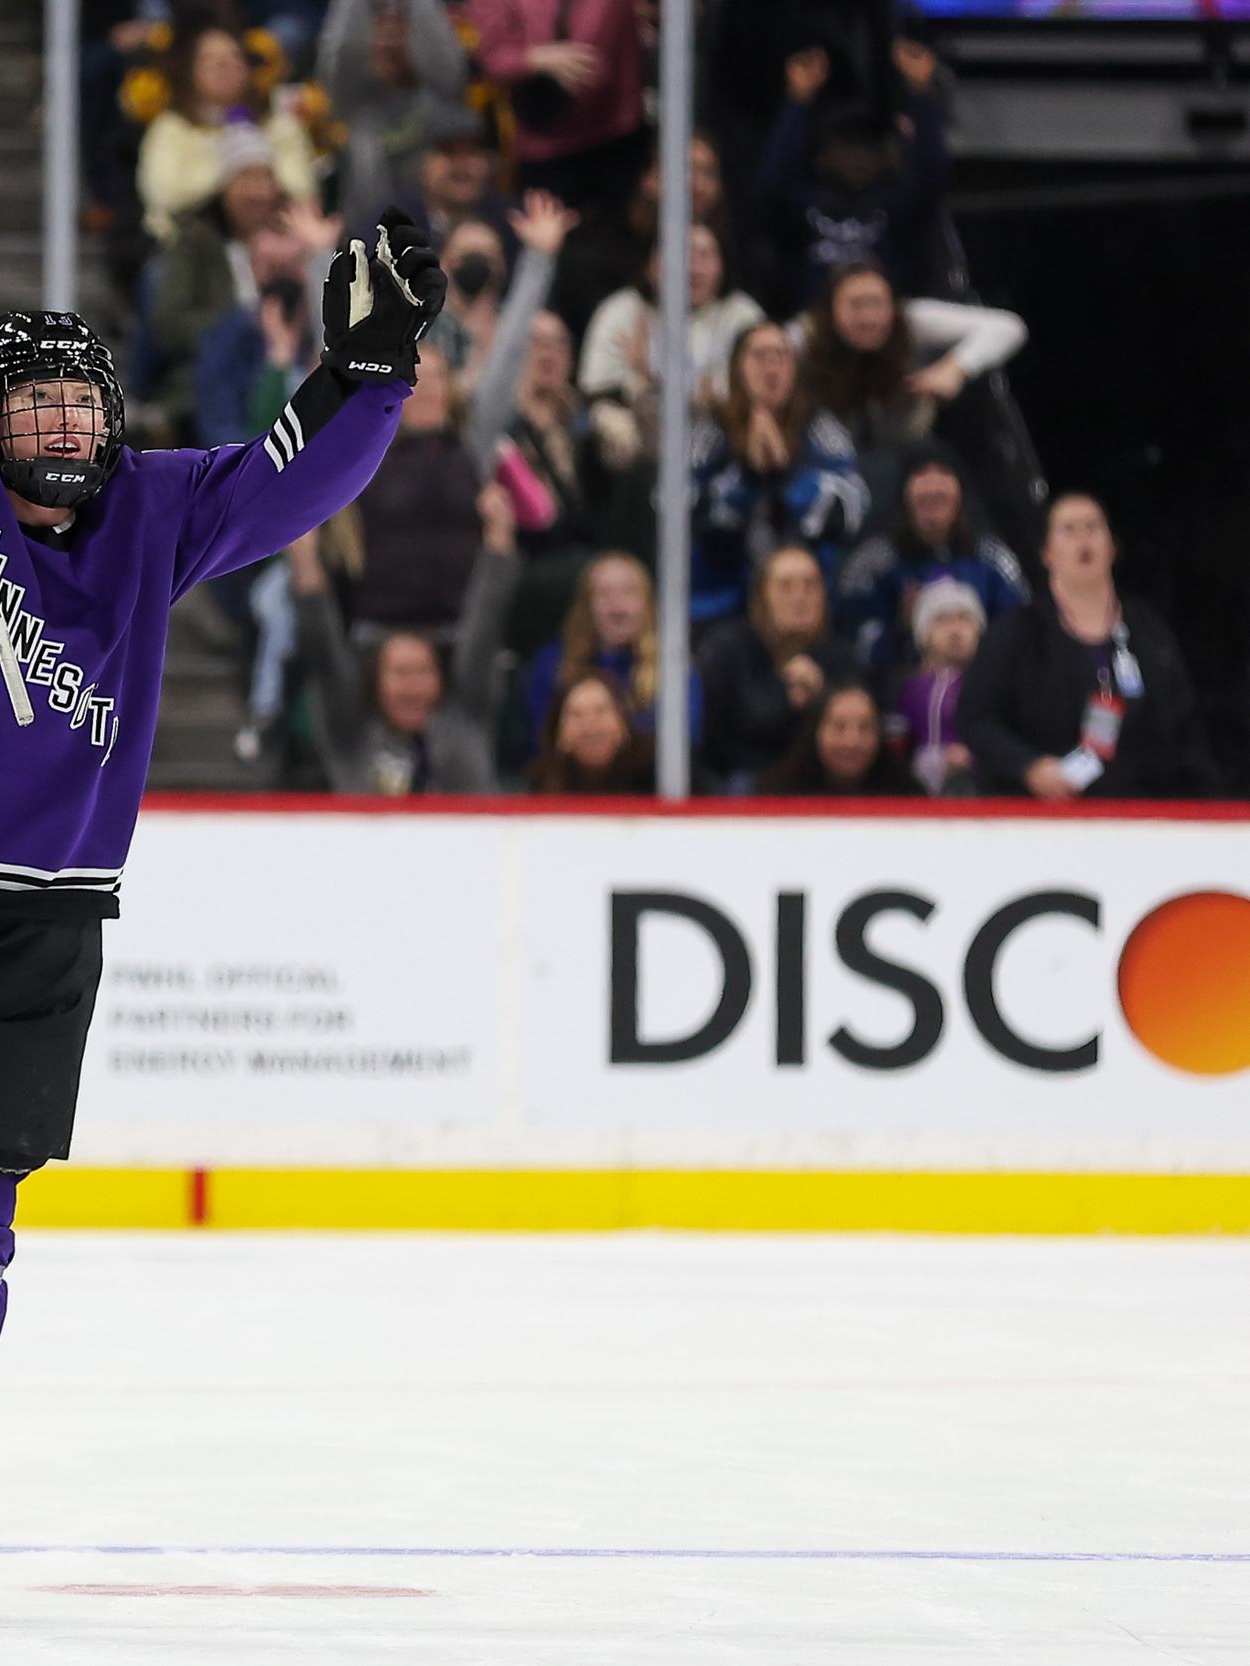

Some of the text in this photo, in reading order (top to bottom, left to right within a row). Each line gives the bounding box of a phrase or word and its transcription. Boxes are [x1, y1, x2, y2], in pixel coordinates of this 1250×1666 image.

[39, 339, 88, 351] CCM
[348, 361, 393, 374] CCM
[45, 471, 86, 484] CCM
[287, 1006, 353, 1034] FOR
[245, 1048, 472, 1075] MANAGEMENT
